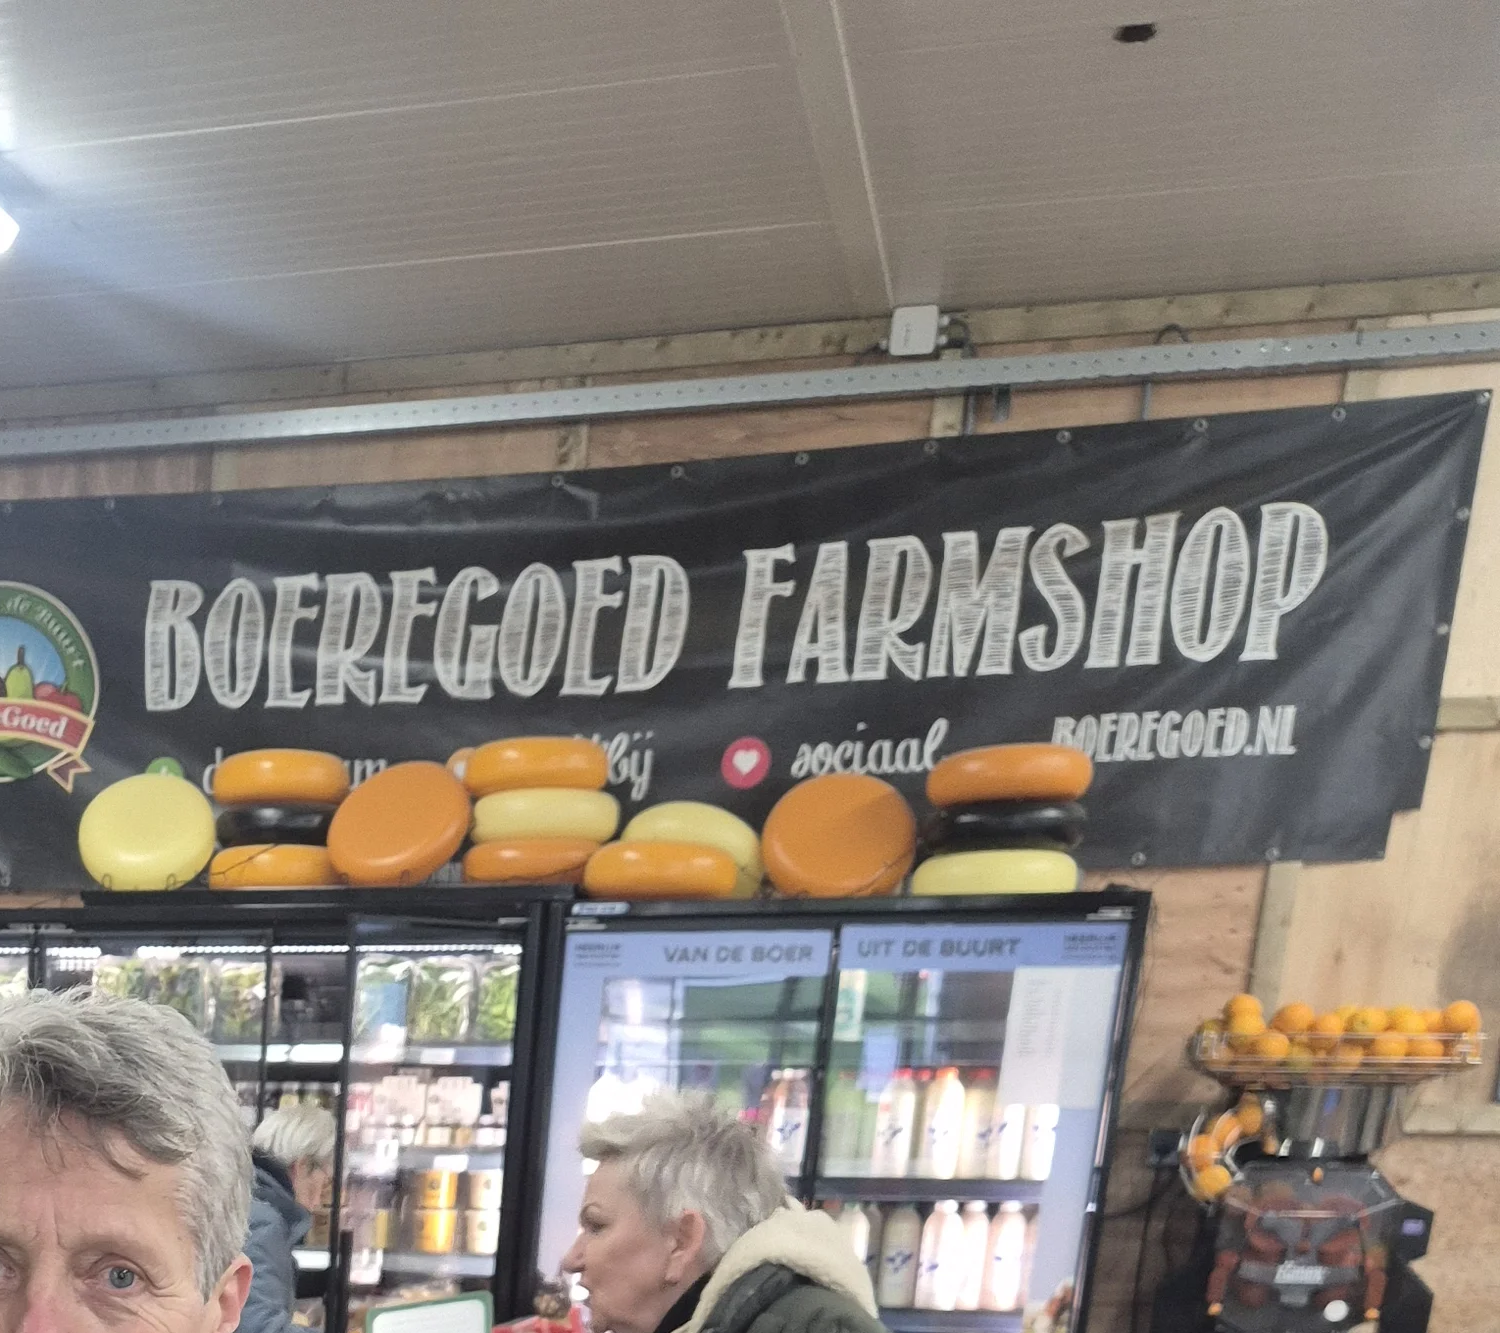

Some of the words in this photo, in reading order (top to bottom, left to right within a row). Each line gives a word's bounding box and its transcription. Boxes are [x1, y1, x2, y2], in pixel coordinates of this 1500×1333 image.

[144, 553, 691, 712] BOEREGOED
[728, 501, 1329, 690] FARMSHOP
[790, 716, 950, 779] sociaal
[1050, 704, 1297, 763] BOEREGOED.NL
[663, 945, 708, 963] VAN
[715, 946, 743, 963] DE
[750, 945, 814, 963] BOER
[857, 938, 896, 958] UIT
[902, 939, 931, 958] DE
[939, 937, 1021, 958] BUURT
